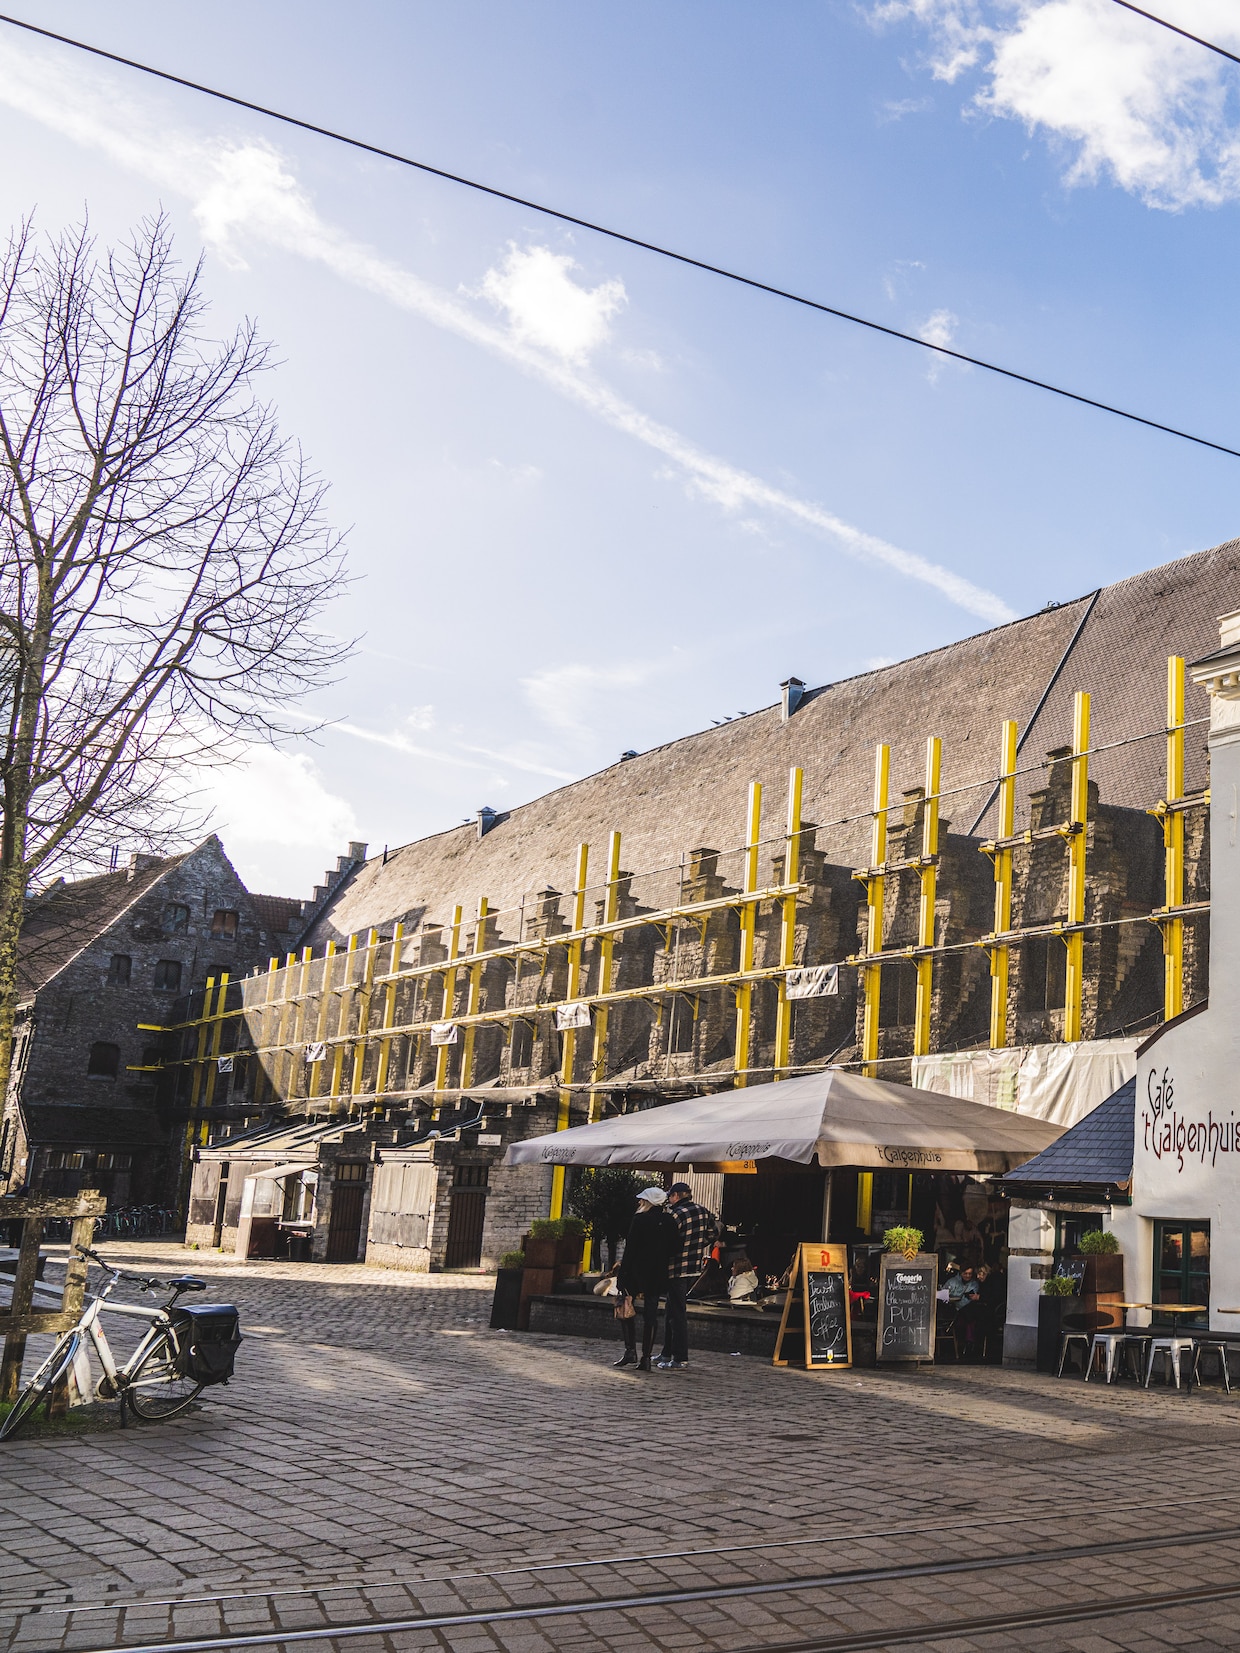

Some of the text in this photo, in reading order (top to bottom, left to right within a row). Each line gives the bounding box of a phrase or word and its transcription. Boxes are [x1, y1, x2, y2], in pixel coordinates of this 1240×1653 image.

[1147, 1066, 1174, 1119] Café
[883, 1145, 942, 1167] Galgenhuis
[895, 1272, 923, 1284] Tongerlo
